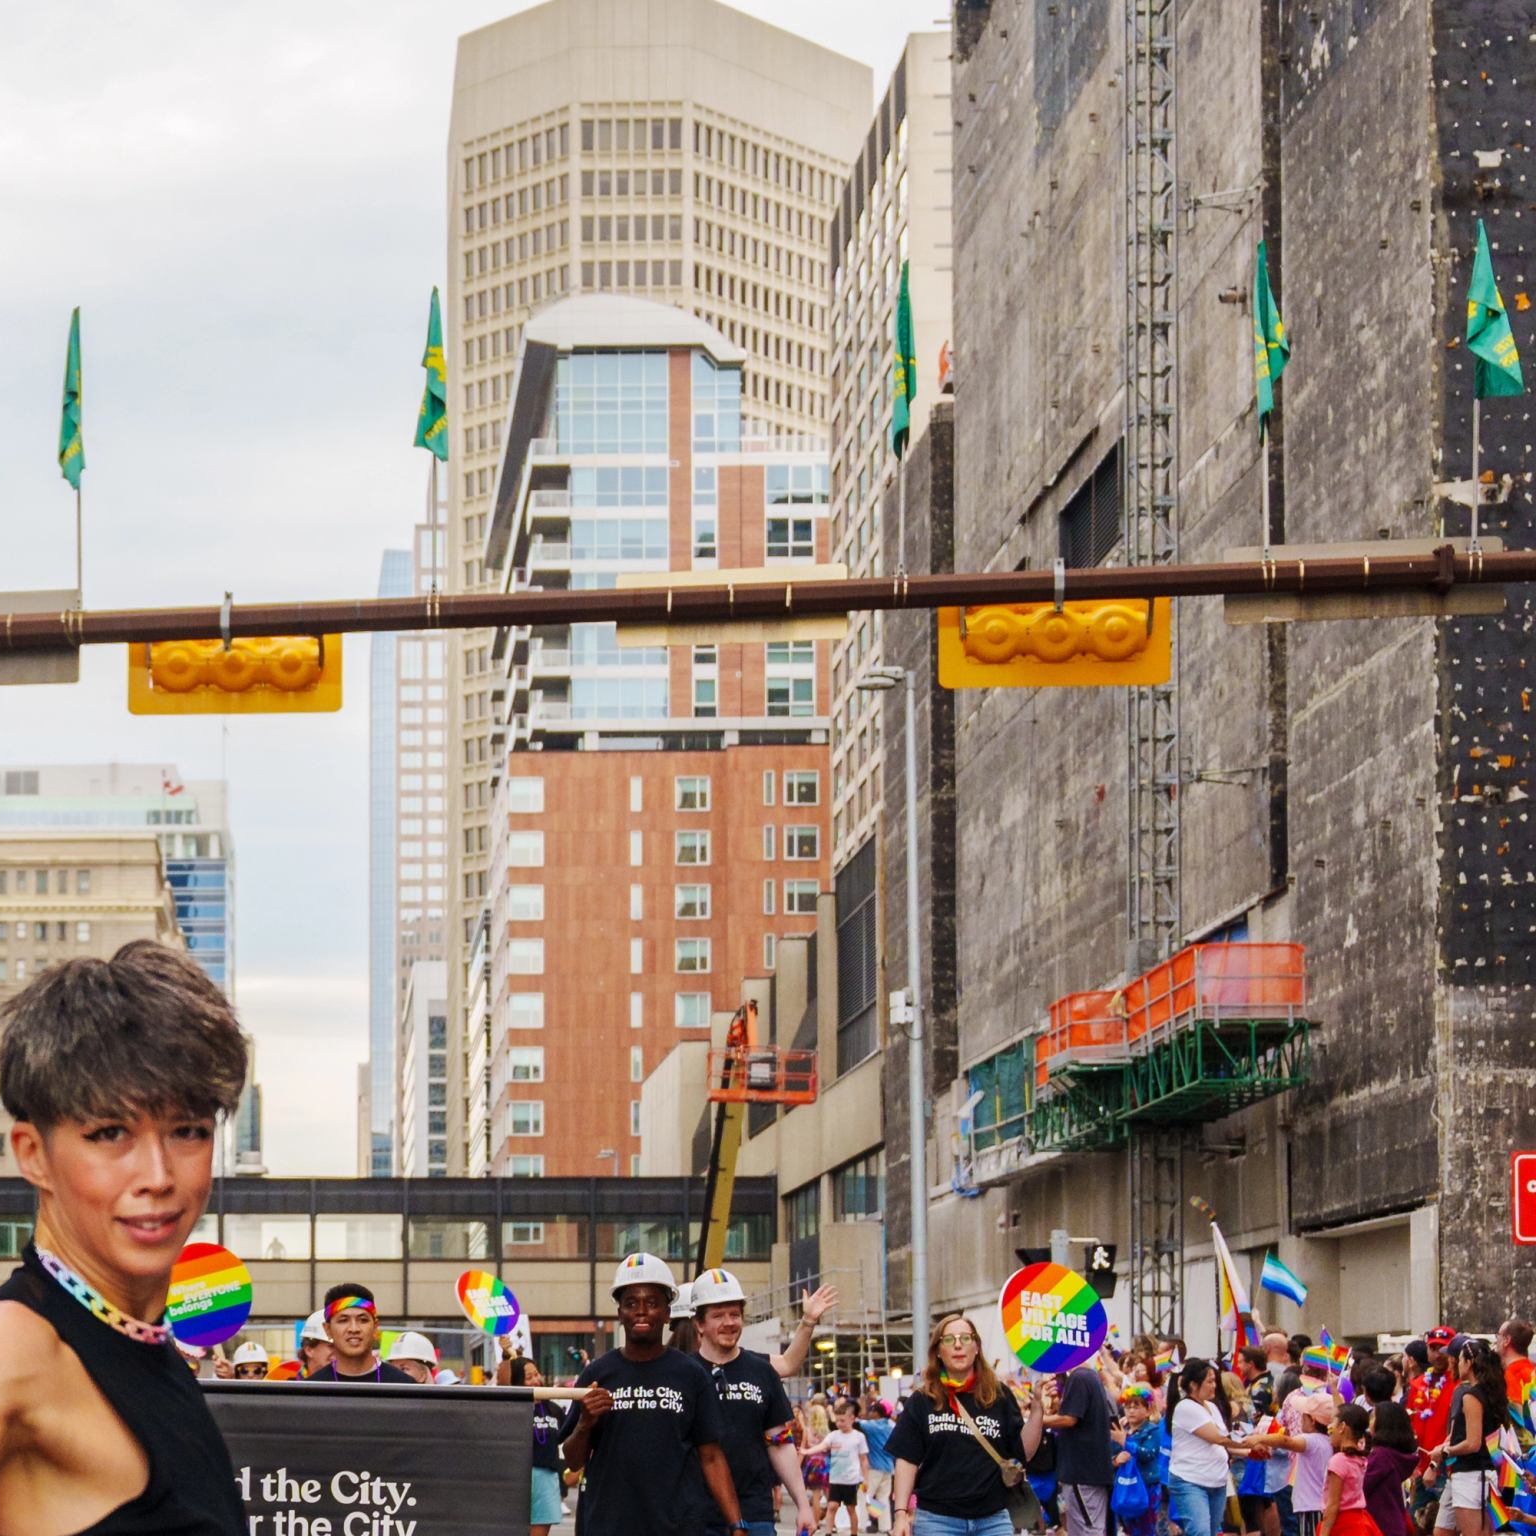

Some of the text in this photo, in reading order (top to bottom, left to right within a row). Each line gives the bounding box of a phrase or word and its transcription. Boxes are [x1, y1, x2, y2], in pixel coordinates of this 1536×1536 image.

[168, 1298, 213, 1317] belongs
[1020, 1290, 1062, 1311] EAST
[1020, 1307, 1087, 1331] VILLAGE
[1021, 1324, 1090, 1348] FOR ALL!
[608, 1386, 683, 1402] uild the City.
[637, 1398, 657, 1409] the
[659, 1398, 684, 1413] City.
[928, 1413, 955, 1424] Build
[975, 1415, 1000, 1427] City.
[929, 1423, 958, 1434] Better
[978, 1425, 1001, 1438] City.
[260, 1467, 322, 1503] the
[331, 1470, 417, 1514] City.
